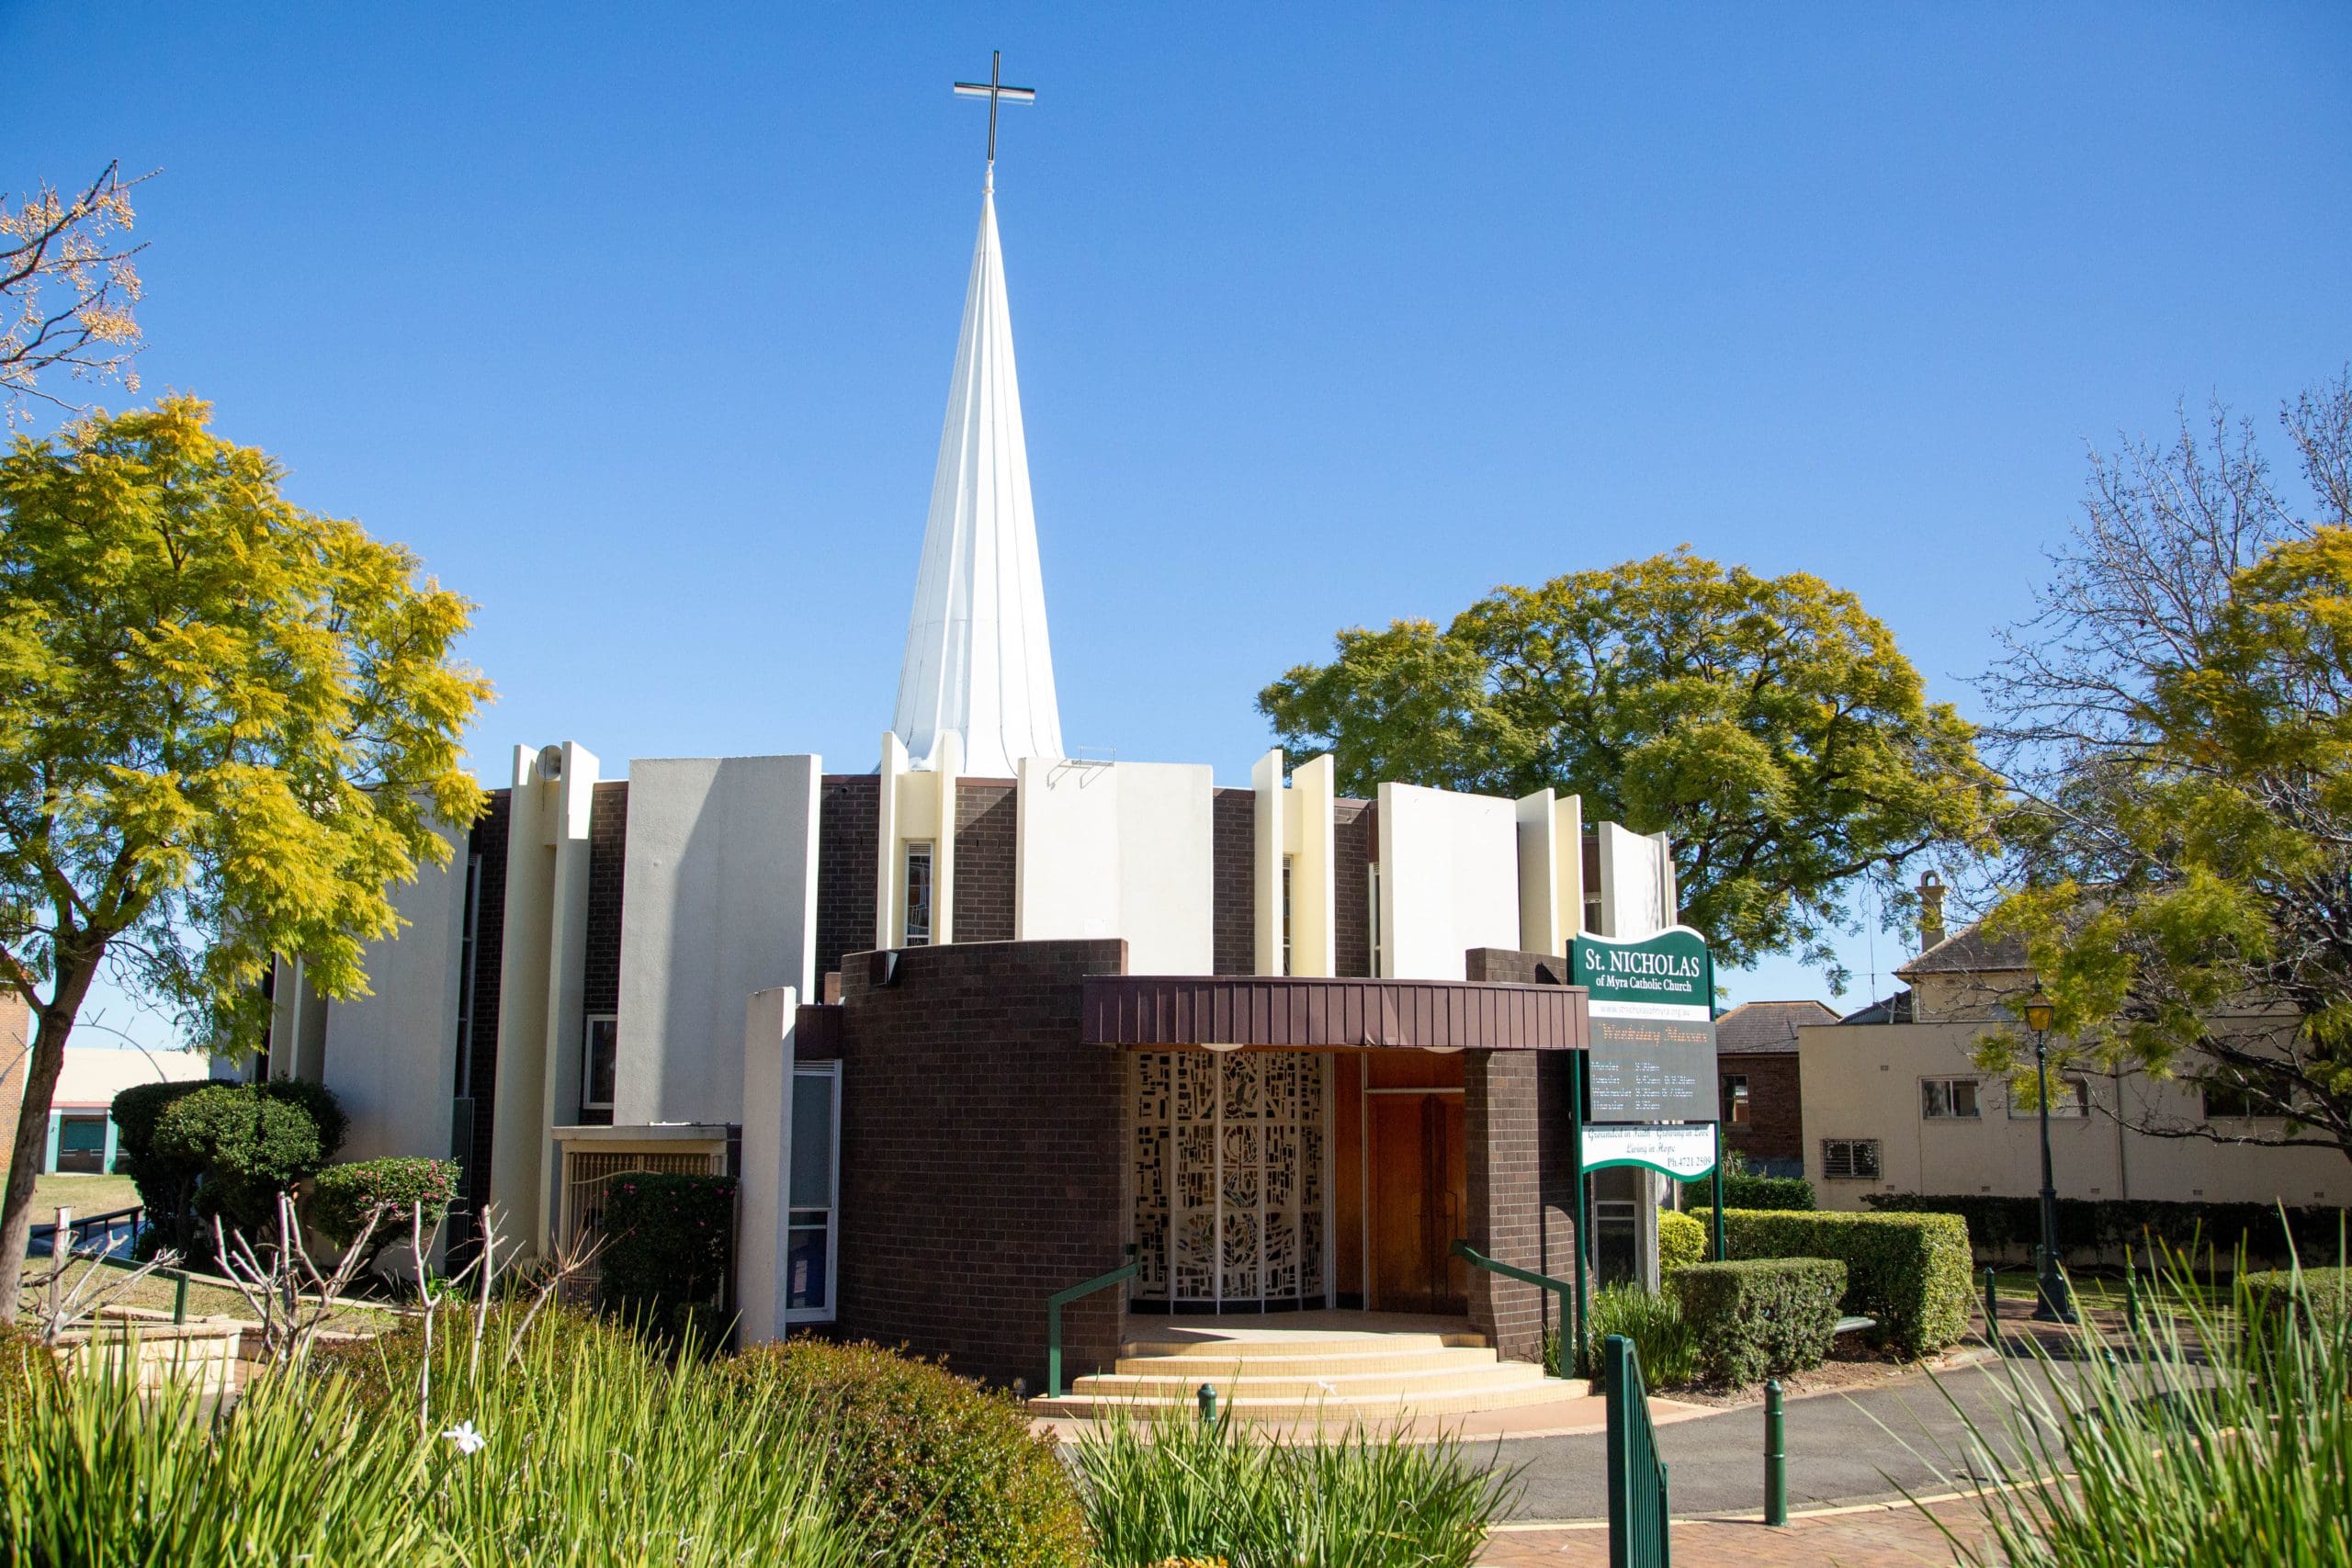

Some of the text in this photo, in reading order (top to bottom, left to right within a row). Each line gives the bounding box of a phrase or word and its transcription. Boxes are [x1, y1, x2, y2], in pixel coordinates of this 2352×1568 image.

[1585, 948, 1700, 977] St. NICHOLAS
[1596, 975, 1692, 992] of Myra Catholic Church
[1588, 1125, 1709, 1141] Grounded in Faith Growing in Love
[1626, 1141, 1675, 1156] Living in Hope
